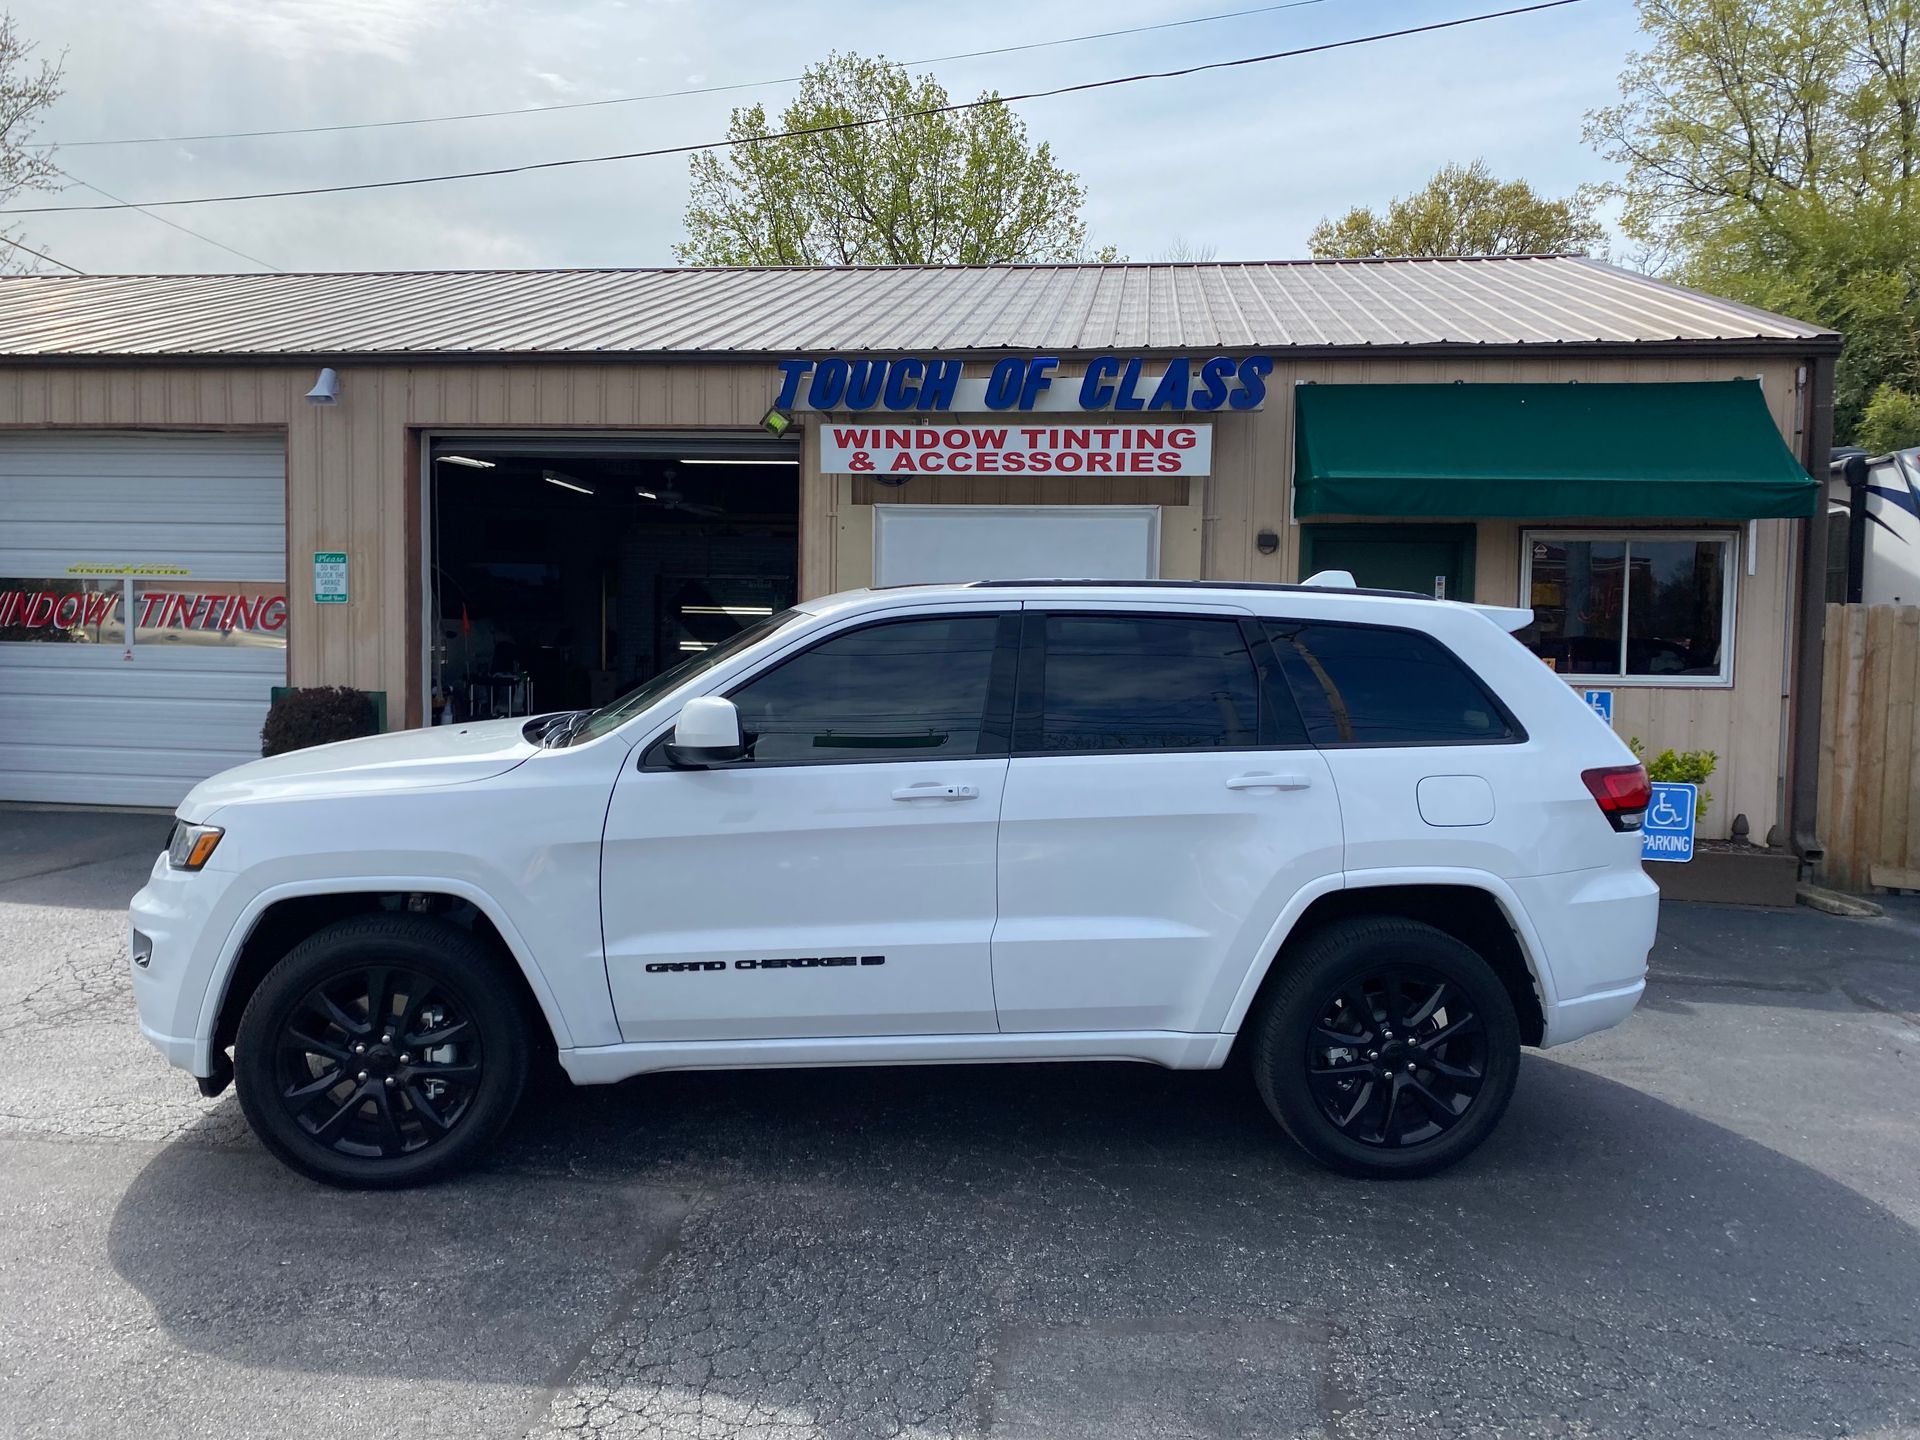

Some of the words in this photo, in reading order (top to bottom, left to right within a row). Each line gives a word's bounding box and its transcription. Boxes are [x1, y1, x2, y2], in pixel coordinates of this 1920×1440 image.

[776, 357, 965, 412] TOUCH
[984, 356, 1060, 411] OF
[1078, 355, 1274, 411] CLASS
[833, 428, 1009, 450] WINDOW
[1020, 428, 1197, 450] TINTING
[848, 451, 877, 472] &
[889, 451, 1182, 473] ACCESSORIES
[139, 593, 287, 631] TINTING
[1643, 835, 1690, 852] PARKING
[645, 961, 726, 972] GRAND
[735, 957, 857, 969] CHEROKEE
